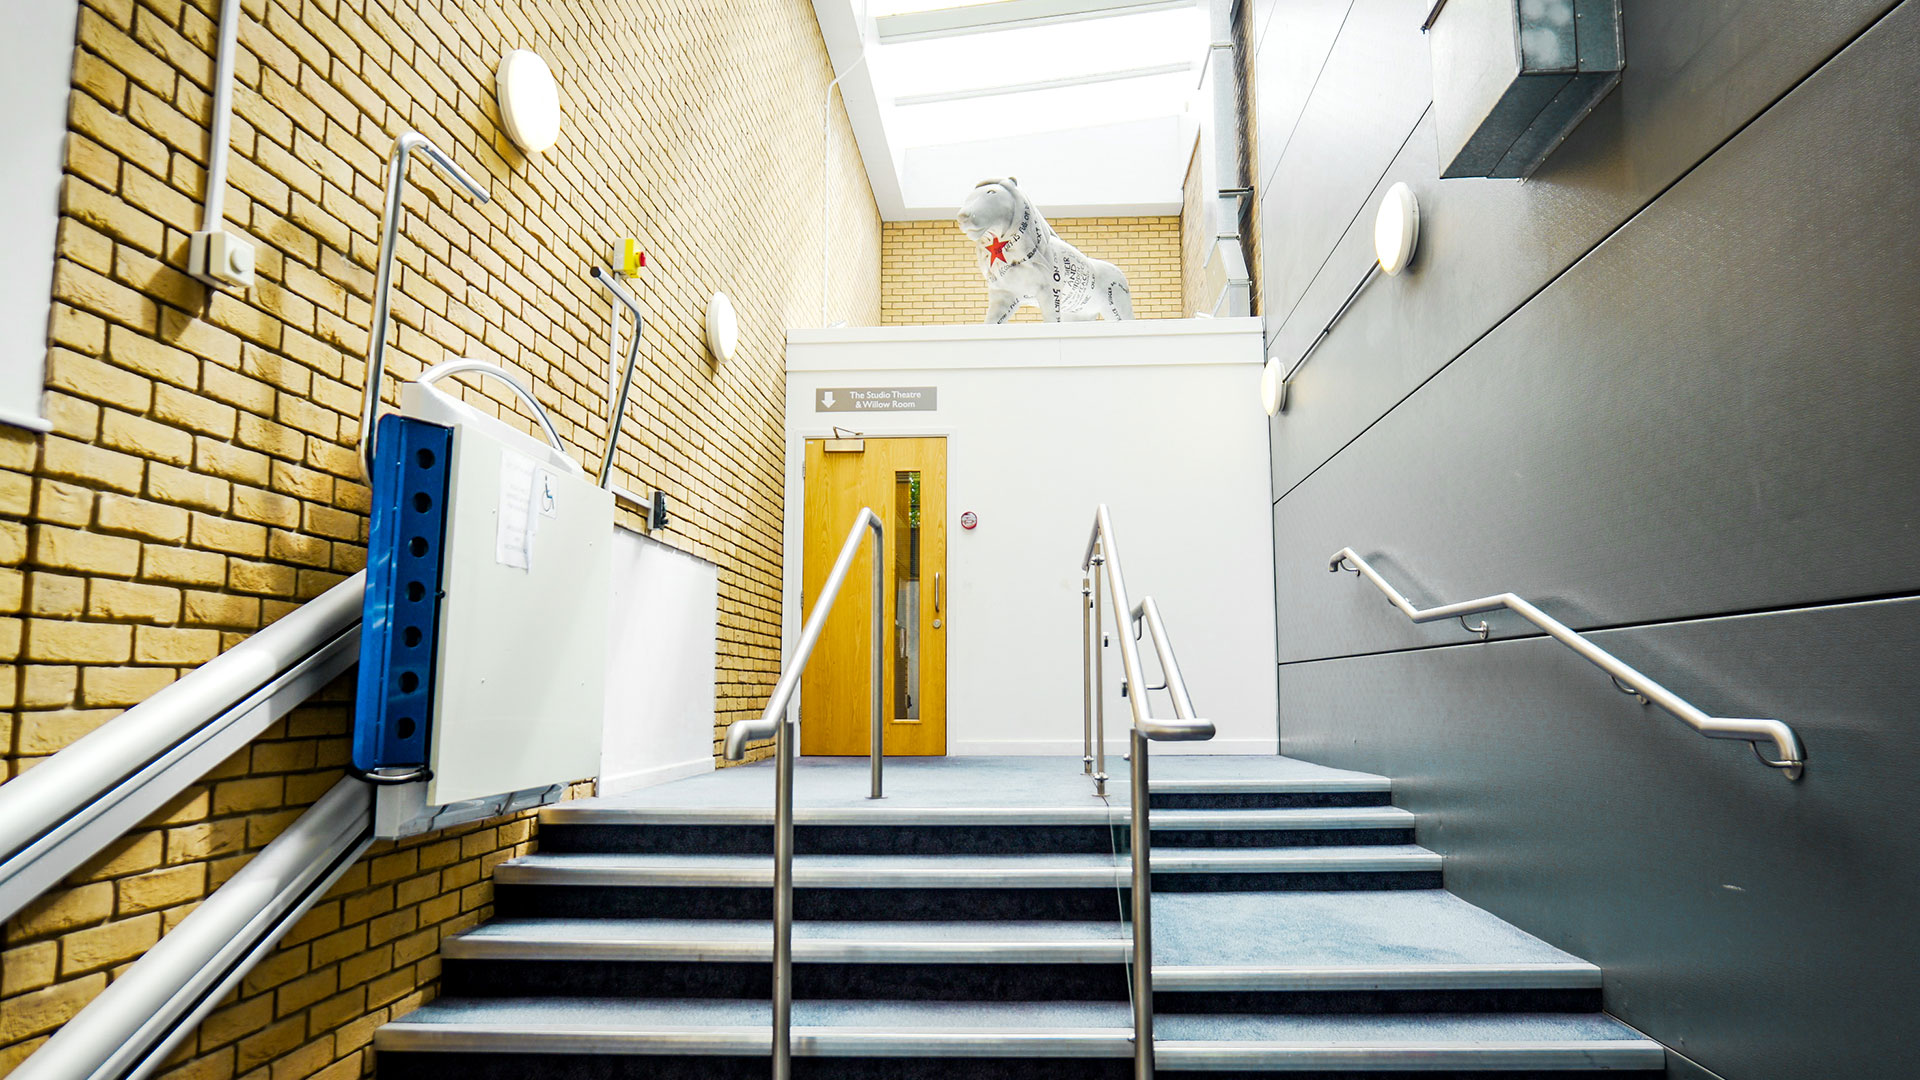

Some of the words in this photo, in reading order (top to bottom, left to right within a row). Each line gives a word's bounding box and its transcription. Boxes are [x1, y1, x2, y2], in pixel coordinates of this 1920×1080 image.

[1053, 265, 1061, 282] ON
[1067, 263, 1077, 287] AND
[850, 391, 865, 399] The
[866, 391, 890, 399] Studio
[892, 390, 921, 399] Theatre
[862, 400, 890, 408] Willow
[892, 400, 916, 408] Room
